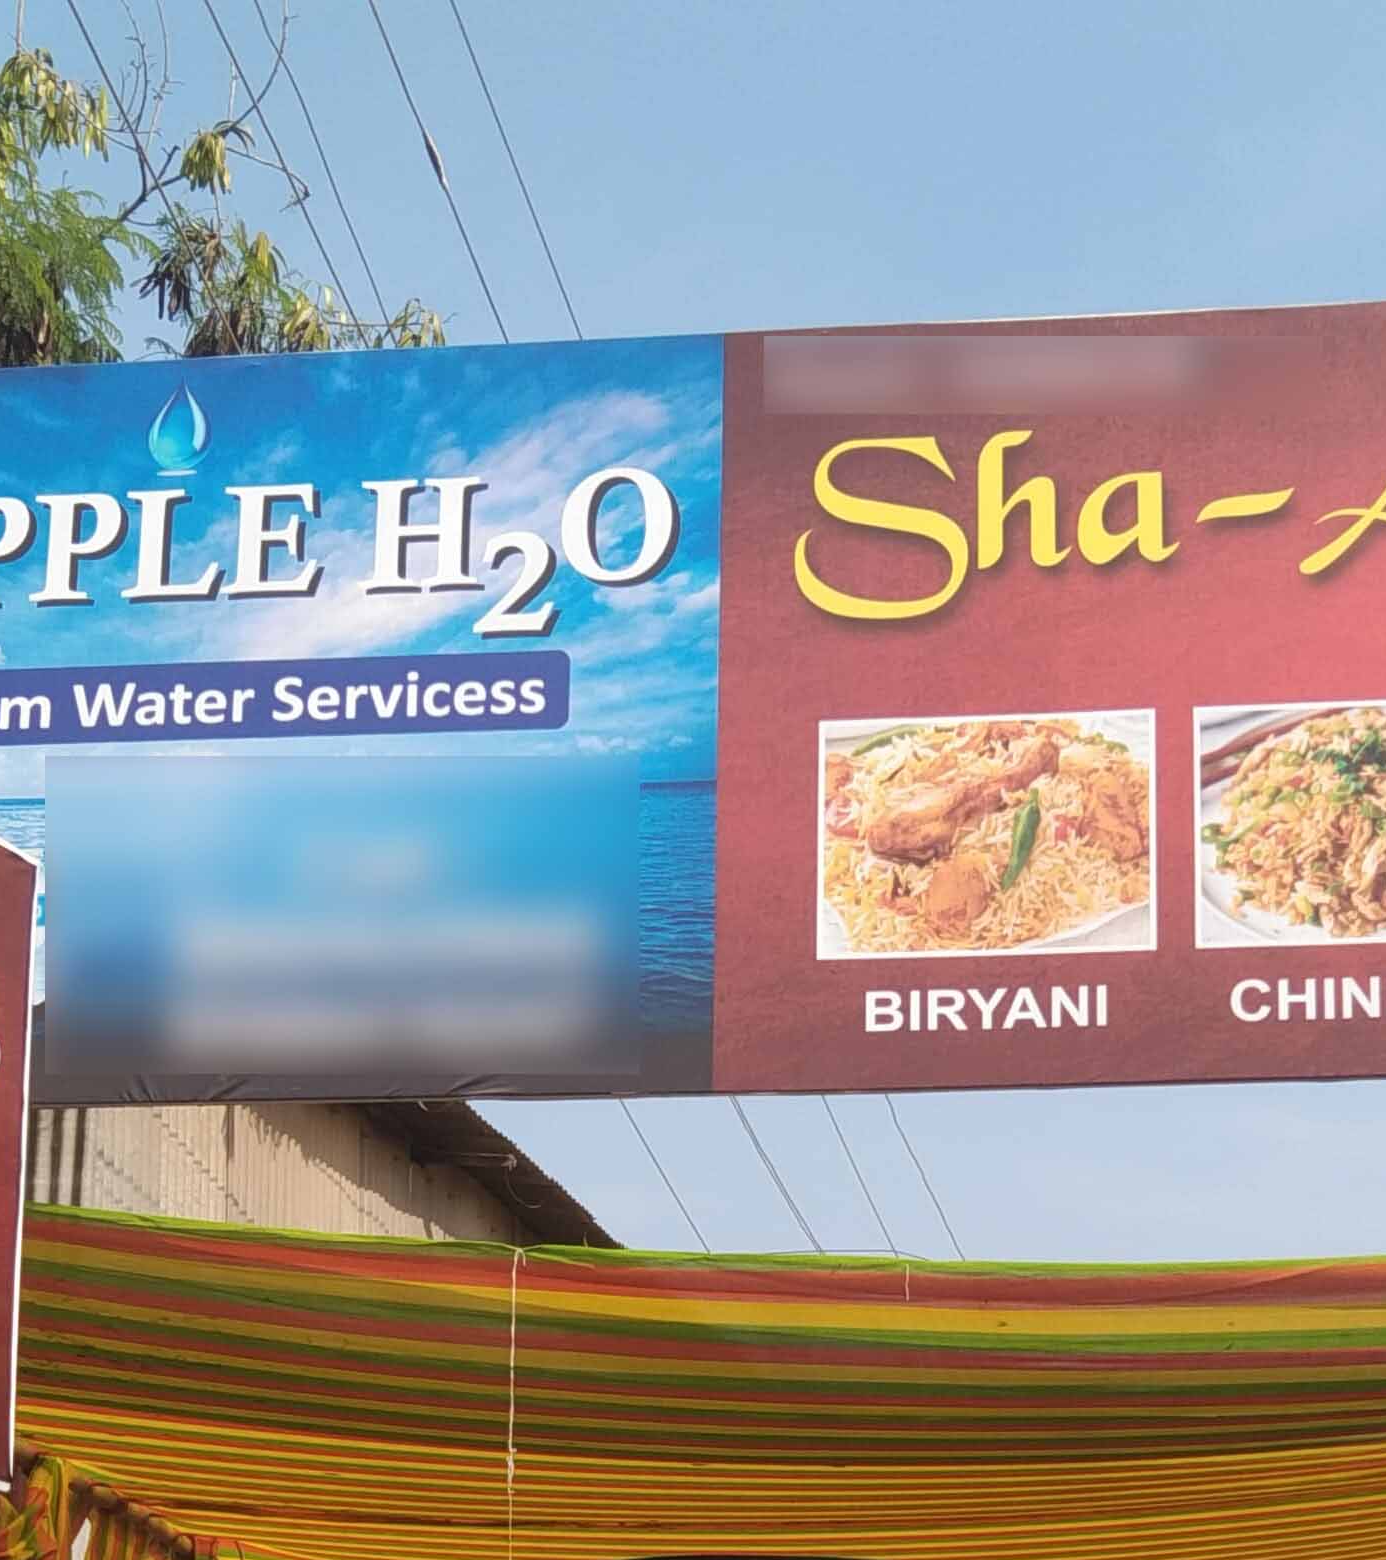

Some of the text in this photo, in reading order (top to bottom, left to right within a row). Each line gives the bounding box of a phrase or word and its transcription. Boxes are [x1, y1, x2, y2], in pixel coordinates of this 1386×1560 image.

[361, 467, 678, 637] H2O
[73, 679, 255, 728] Water
[271, 671, 547, 723] Servicess
[865, 984, 1108, 1033] BIRYANI
